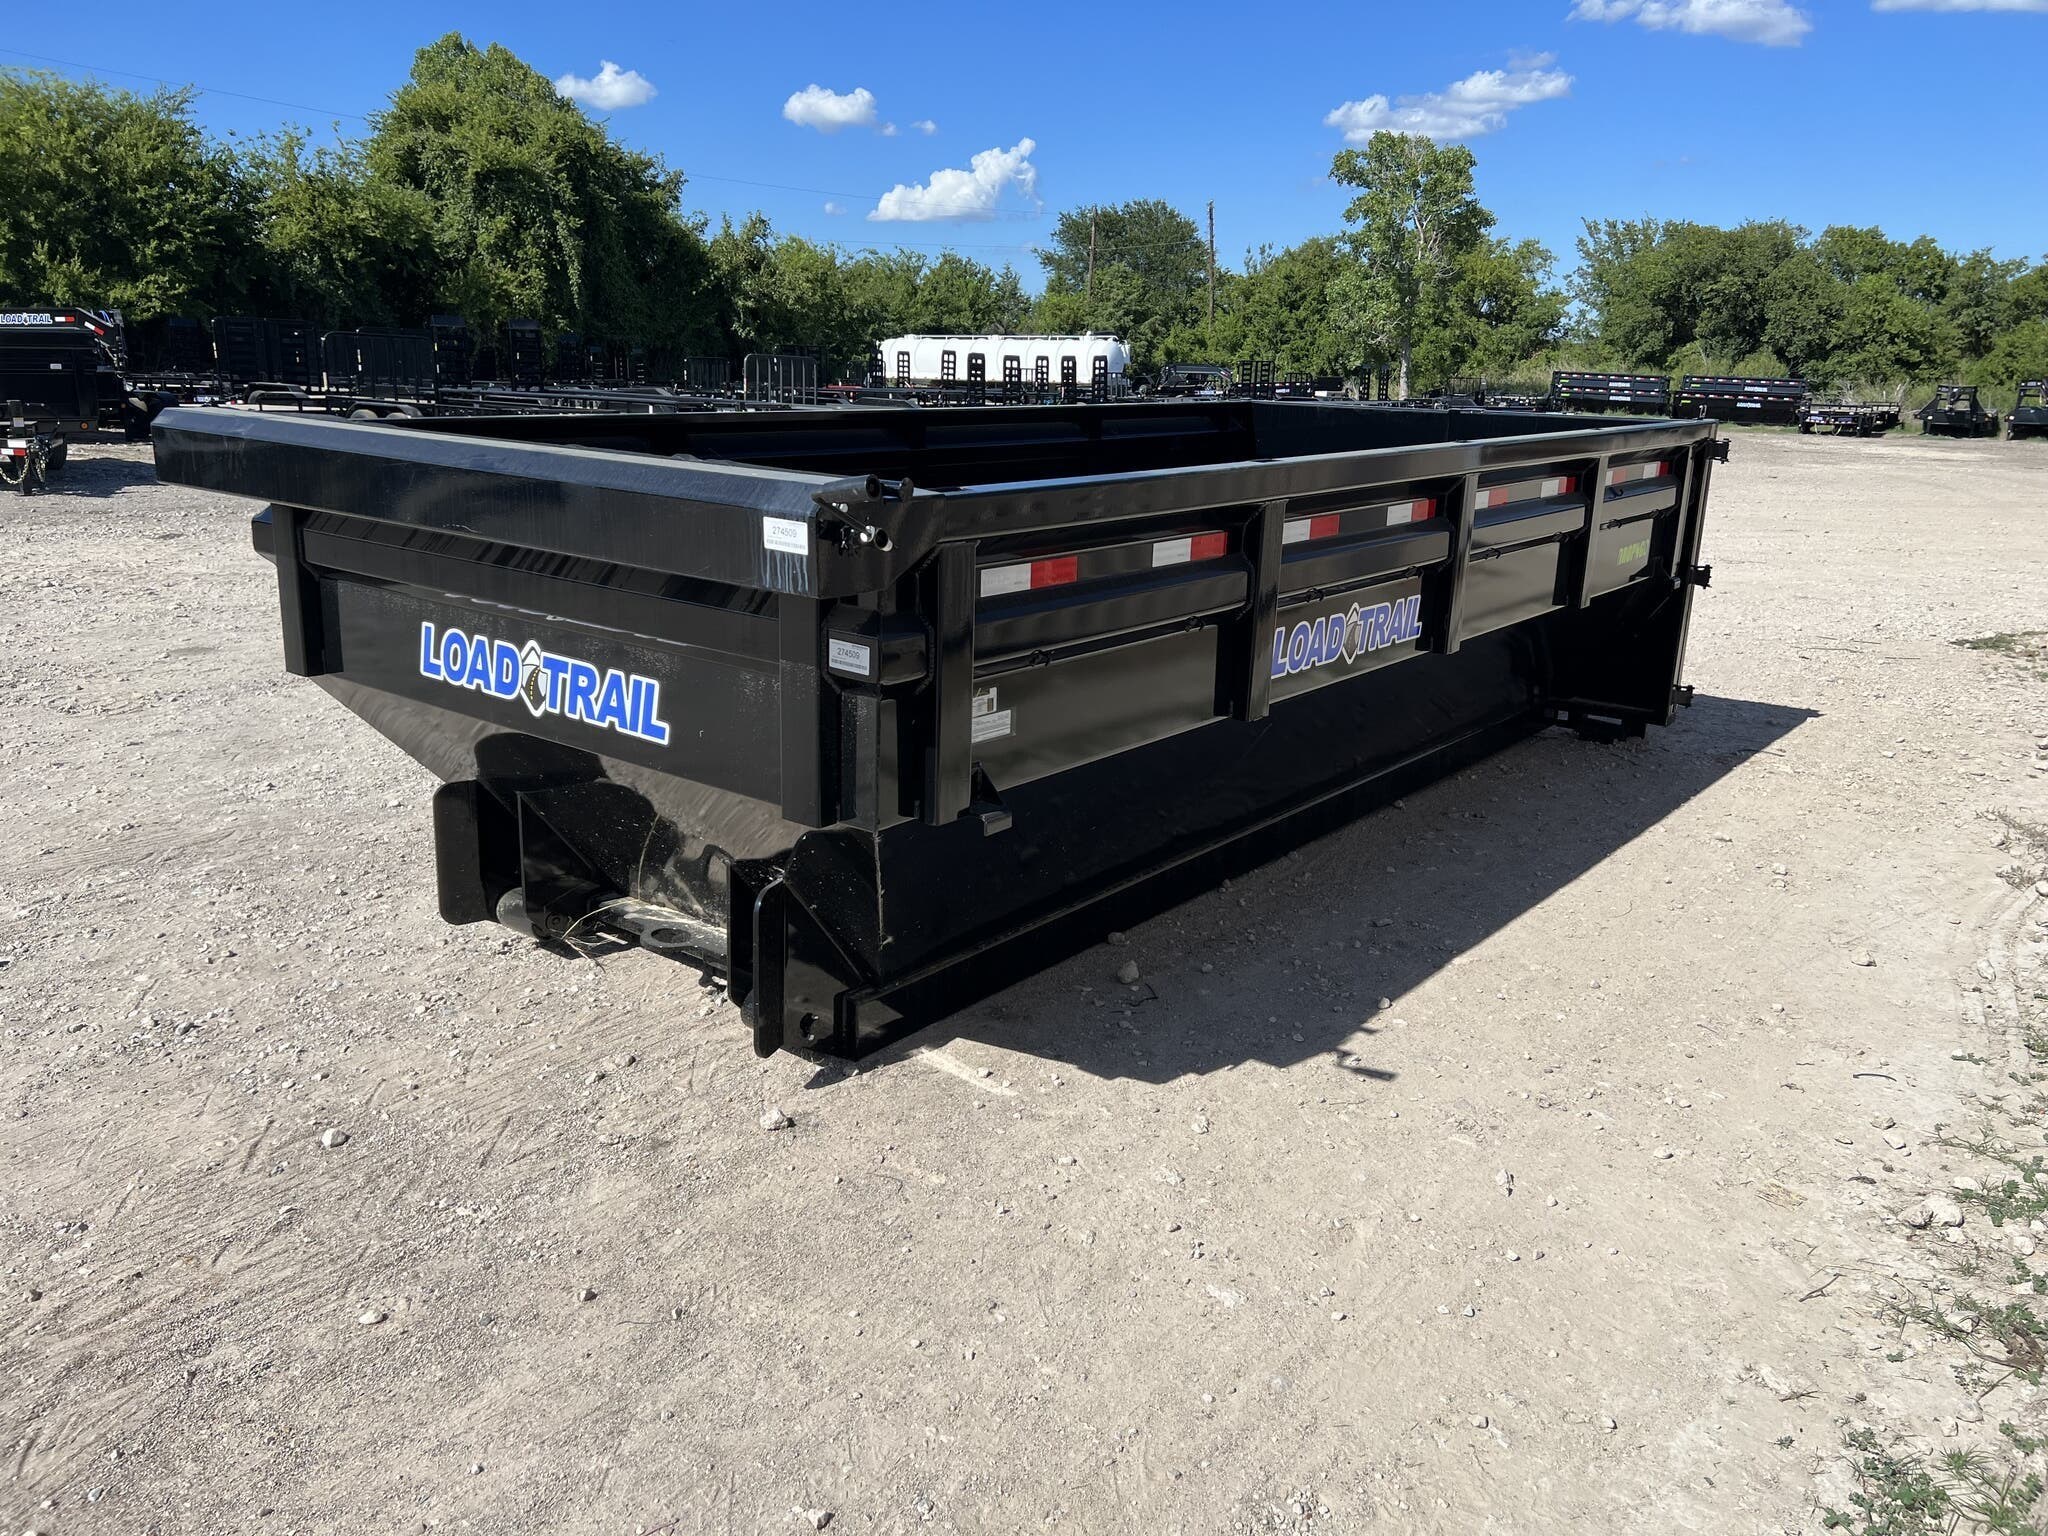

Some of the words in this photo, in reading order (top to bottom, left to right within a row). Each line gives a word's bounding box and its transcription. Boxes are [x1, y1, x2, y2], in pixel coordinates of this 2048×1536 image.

[0, 313, 23, 324] LOAD
[26, 313, 53, 324] TRAIL
[771, 526, 797, 538] 274509
[1271, 613, 1346, 679] LOAD
[1357, 594, 1422, 654] TRAIL
[836, 647, 860, 660] 274509
[420, 621, 522, 700] LOAD
[540, 651, 670, 745] TRAIL
